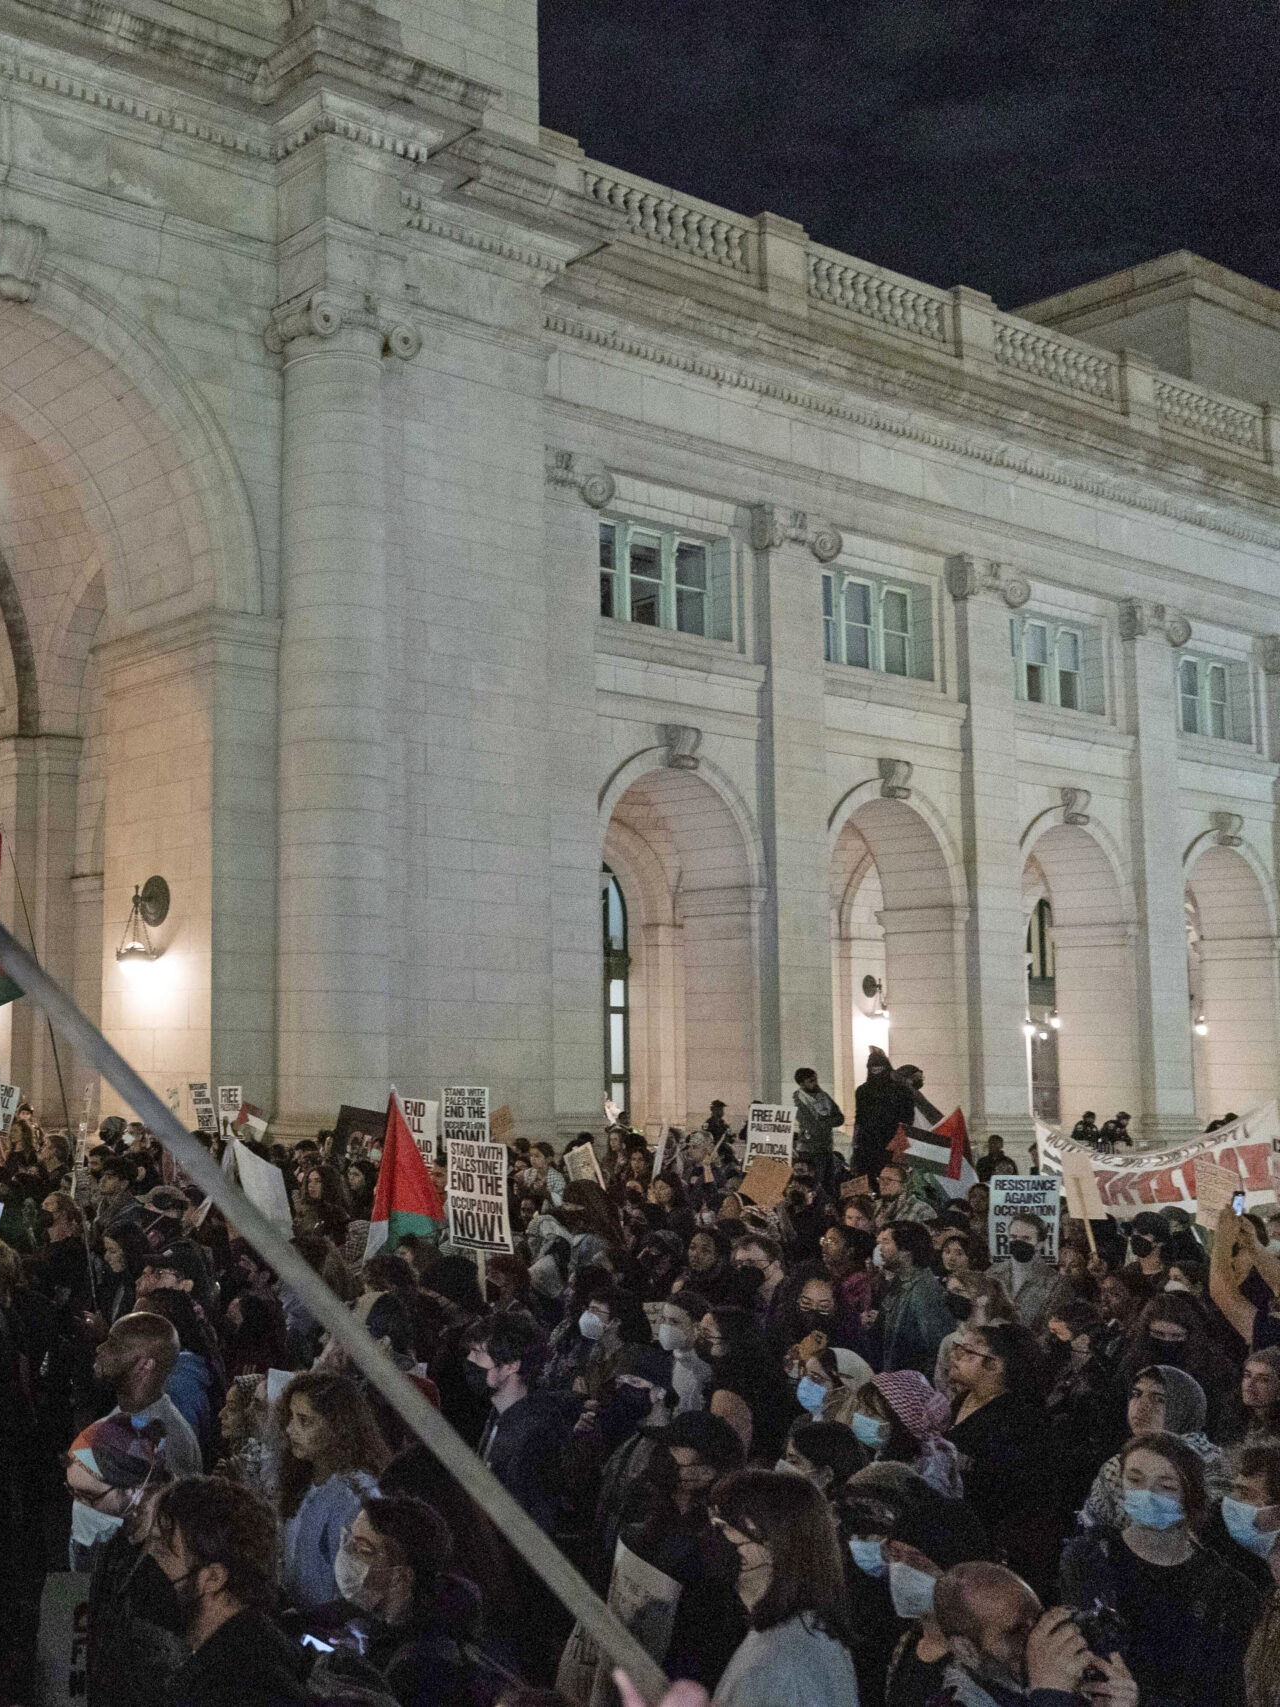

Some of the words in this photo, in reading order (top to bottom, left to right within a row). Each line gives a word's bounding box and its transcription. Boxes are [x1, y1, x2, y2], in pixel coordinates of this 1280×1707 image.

[221, 1088, 238, 1103] FREE
[444, 1088, 465, 1096] STAND
[467, 1088, 485, 1096] WITH
[445, 1097, 485, 1105] PALESTINE!
[404, 1100, 425, 1117] END
[445, 1106, 464, 1118] END
[467, 1106, 486, 1118] THE
[752, 1109, 773, 1121] FREE
[775, 1110, 792, 1123] ALL
[451, 1142, 474, 1157] STAND
[477, 1145, 503, 1160] WITH
[750, 1143, 789, 1156] POLITICAL
[451, 1156, 502, 1175] PALESTINE!
[451, 1171, 474, 1192] END
[477, 1175, 503, 1196] THE
[995, 1179, 1056, 1191] RESISTANCE
[451, 1195, 503, 1214] OCCUPATION
[1004, 1192, 1047, 1204] AGAINST
[452, 1209, 505, 1242] NOW!
[996, 1221, 1006, 1233] IS
